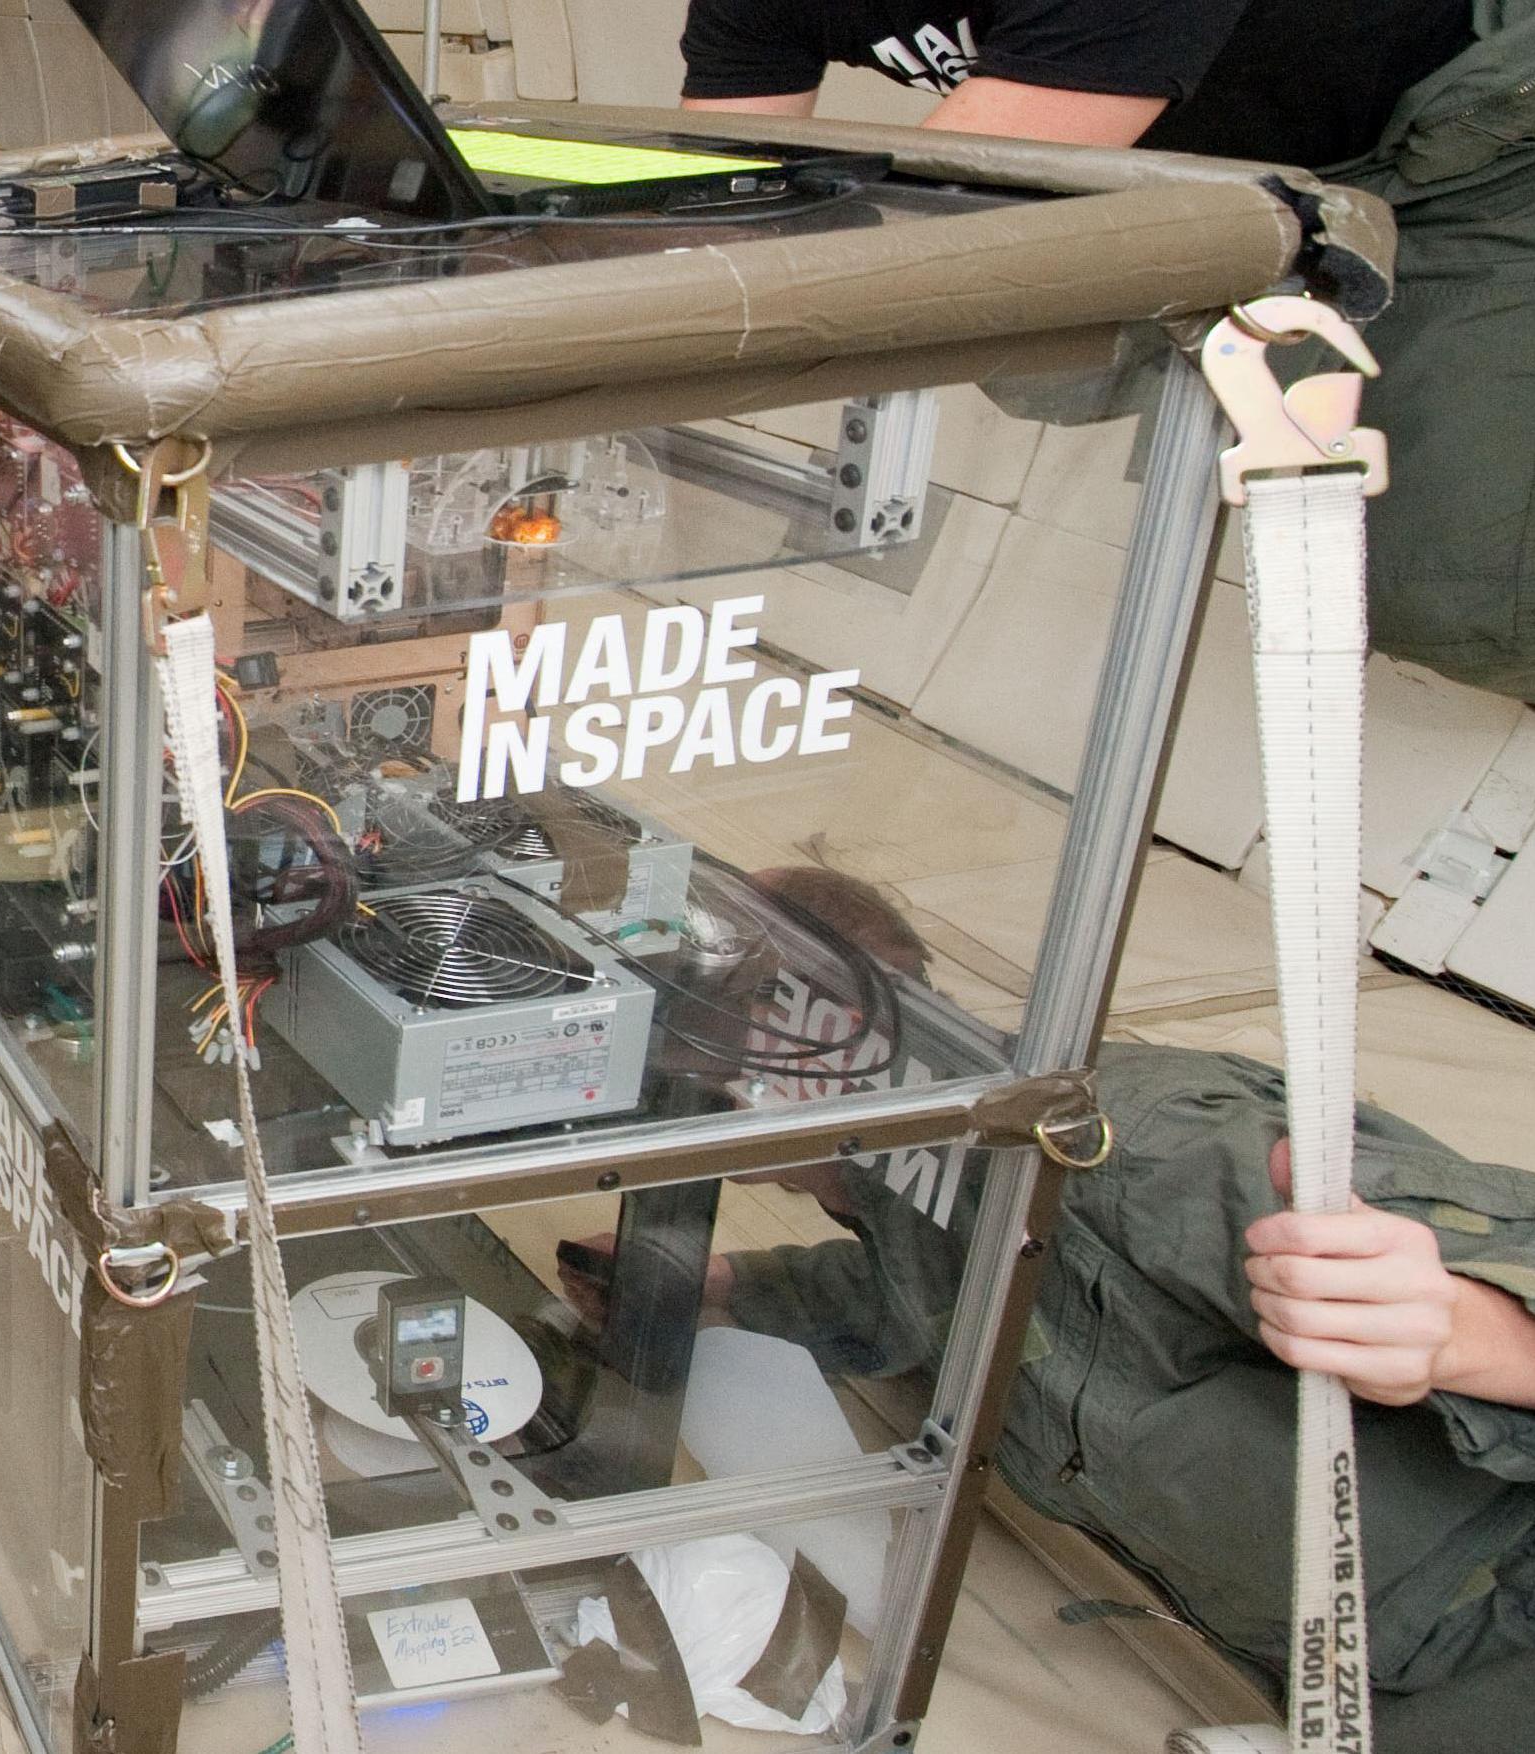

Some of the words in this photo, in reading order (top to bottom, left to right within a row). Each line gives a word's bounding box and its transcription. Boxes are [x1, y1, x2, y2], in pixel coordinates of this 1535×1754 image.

[466, 594, 765, 713] MADE
[456, 715, 551, 803] IN
[560, 668, 861, 788] SPACE
[1302, 1617, 1325, 1691] 5000
[1334, 1592, 1357, 1653] CL2
[1300, 1700, 1324, 1750] LB.
